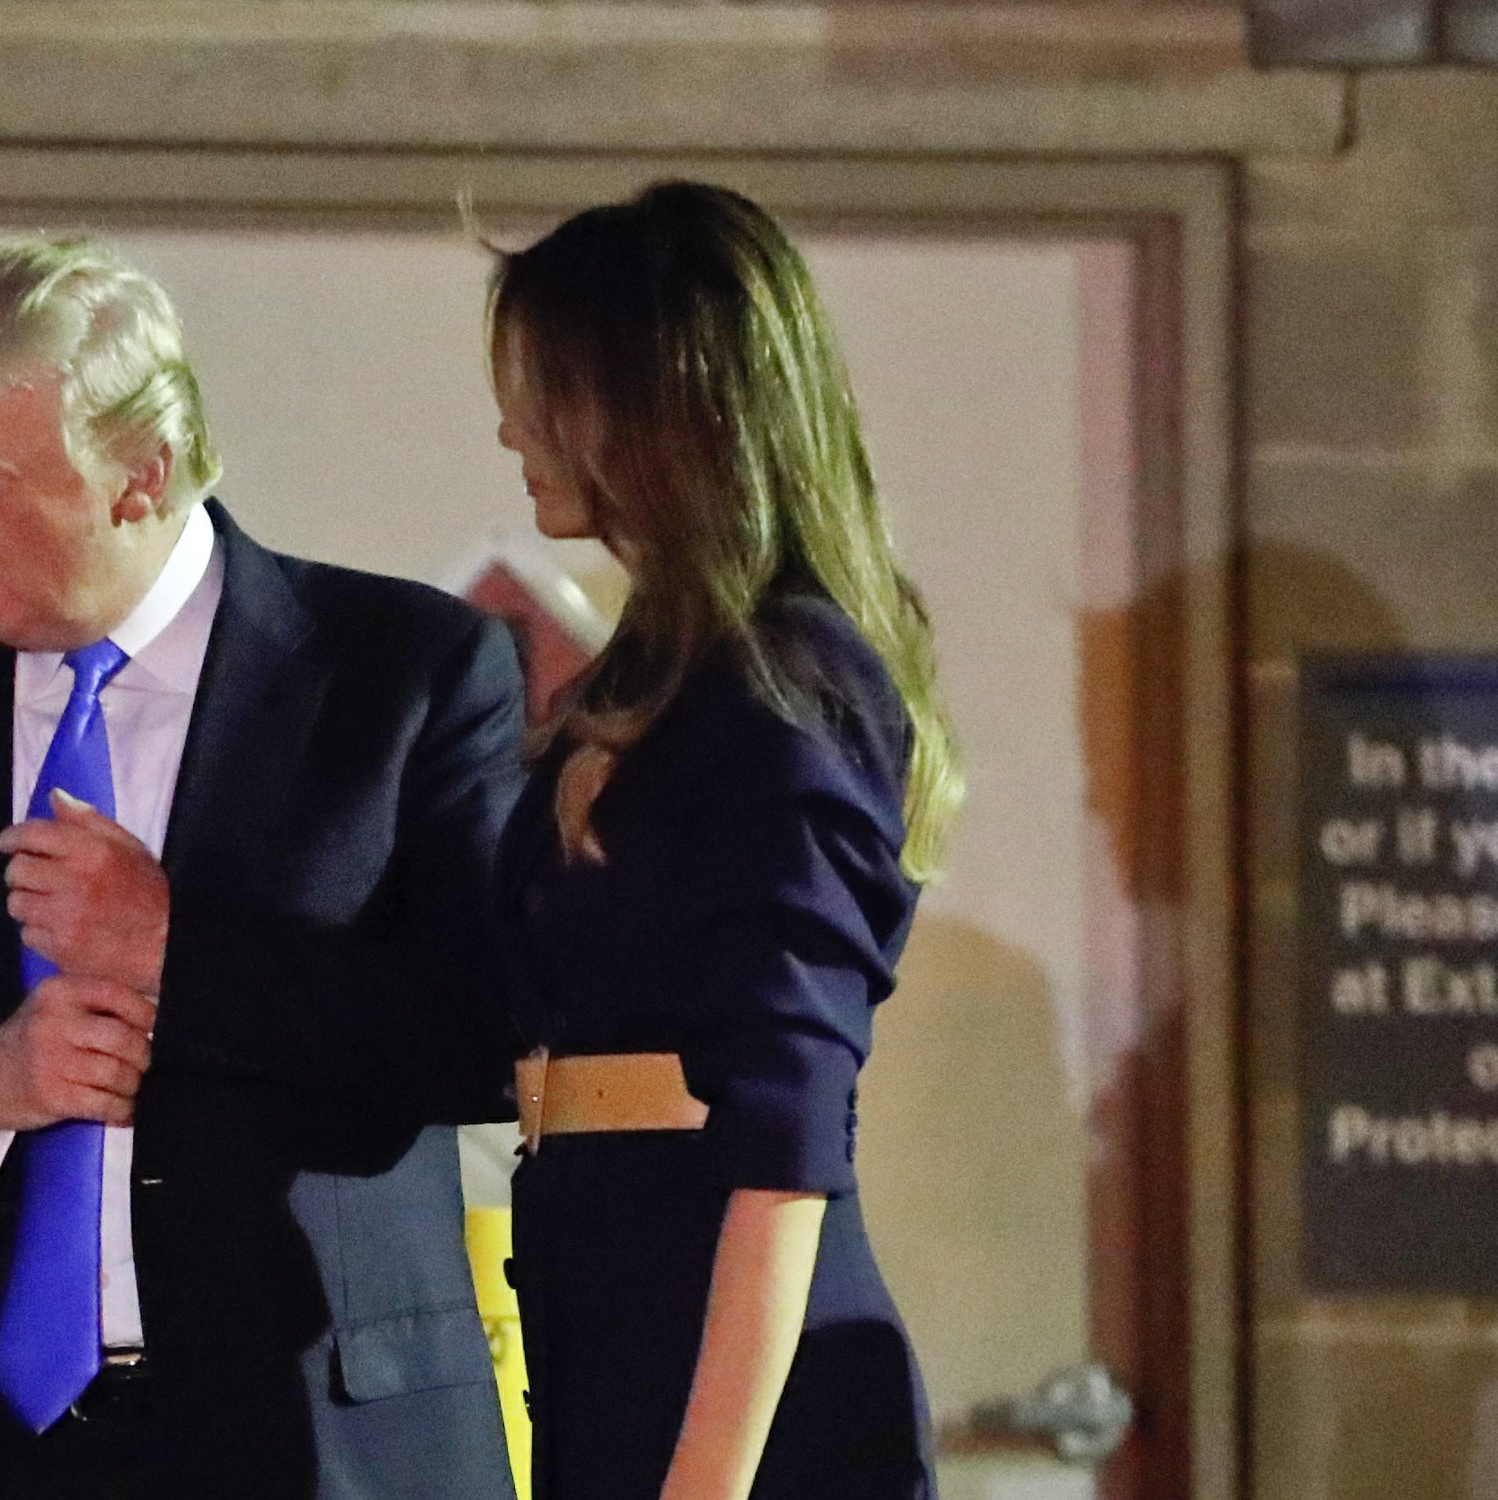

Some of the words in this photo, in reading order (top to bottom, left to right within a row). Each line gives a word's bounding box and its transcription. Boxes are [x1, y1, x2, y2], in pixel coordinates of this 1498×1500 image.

[1349, 734, 1404, 787] In
[1320, 819, 1381, 865] or
[1398, 810, 1437, 864] if
[1332, 963, 1387, 1014] at
